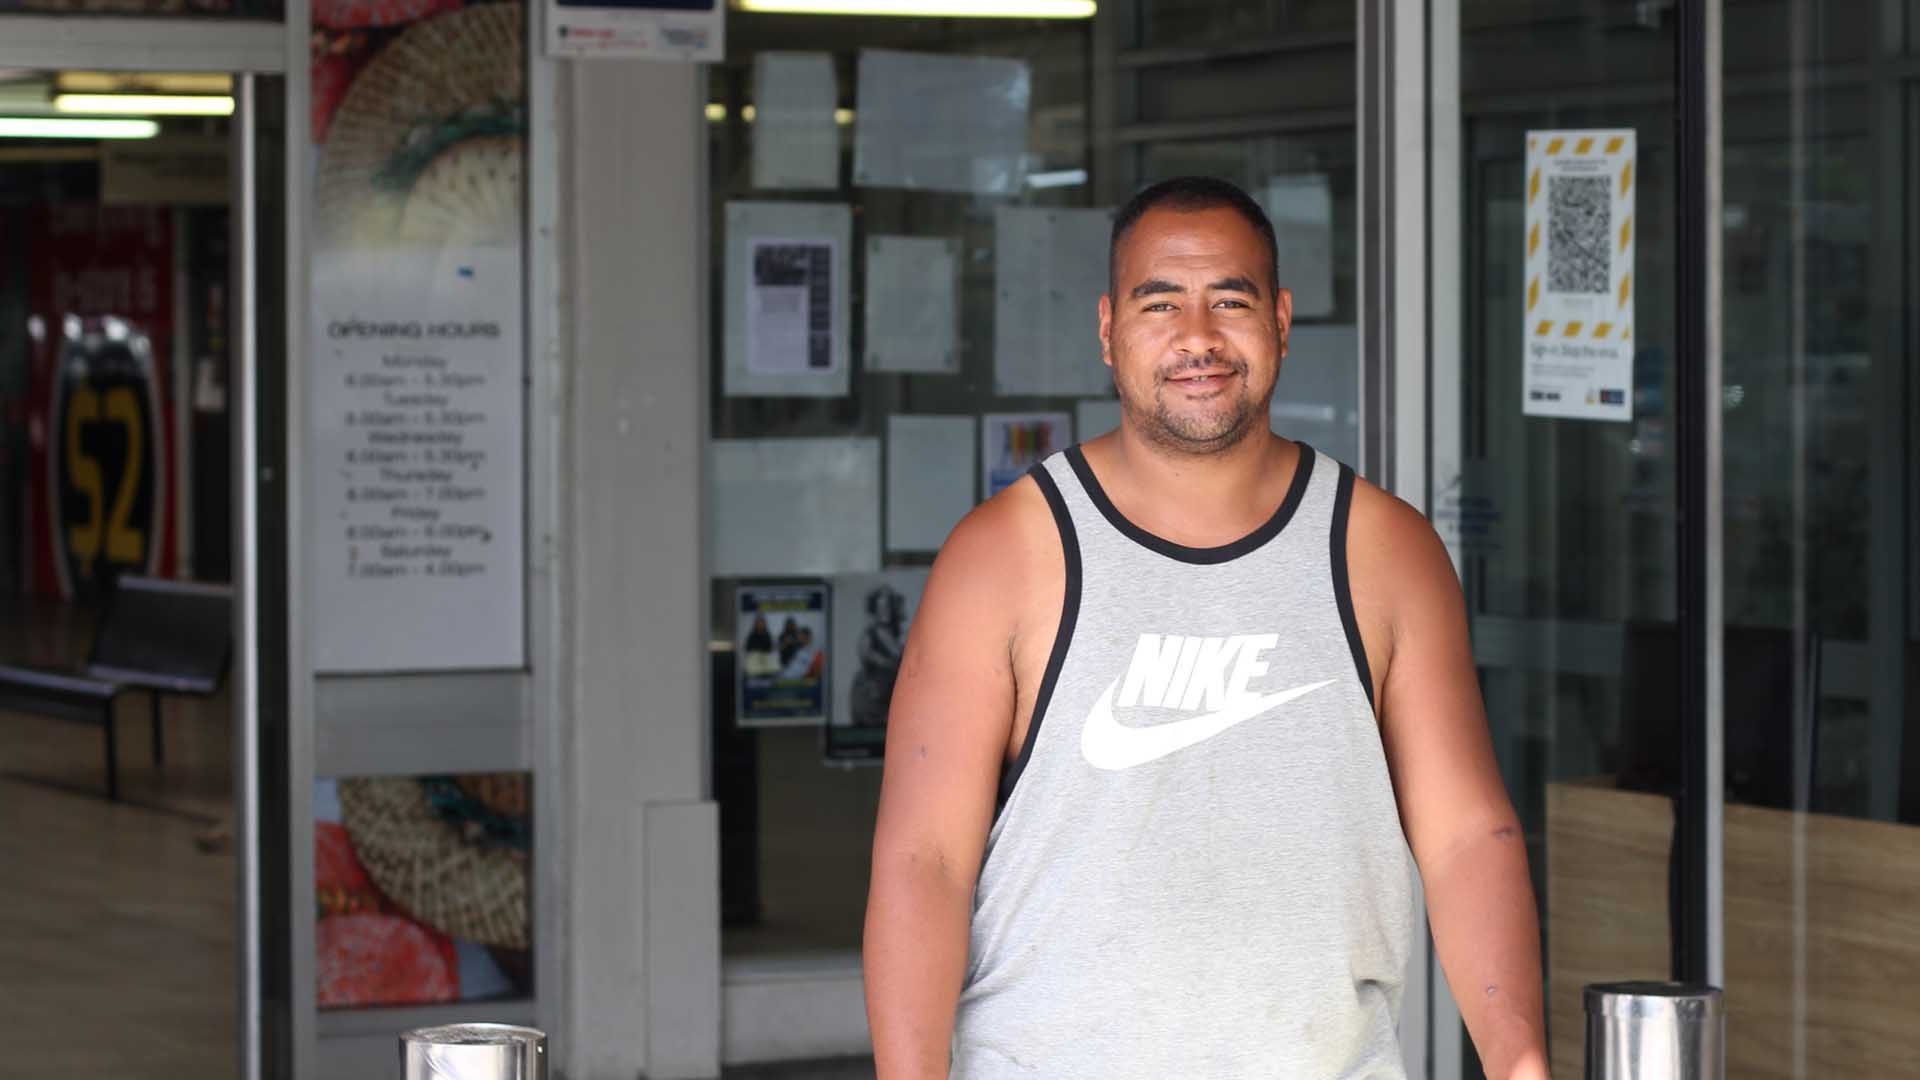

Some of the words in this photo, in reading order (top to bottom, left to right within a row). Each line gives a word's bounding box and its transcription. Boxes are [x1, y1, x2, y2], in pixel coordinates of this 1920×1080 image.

[328, 321, 423, 339] OPENING
[427, 321, 502, 339] HOURS
[381, 354, 448, 370] Monday
[383, 391, 449, 408] Tuesday
[368, 431, 464, 447] Wednesday
[379, 468, 454, 484] Thursday
[391, 505, 442, 522] Friday
[380, 544, 453, 560] Saturday
[1115, 633, 1280, 713] NIKE
